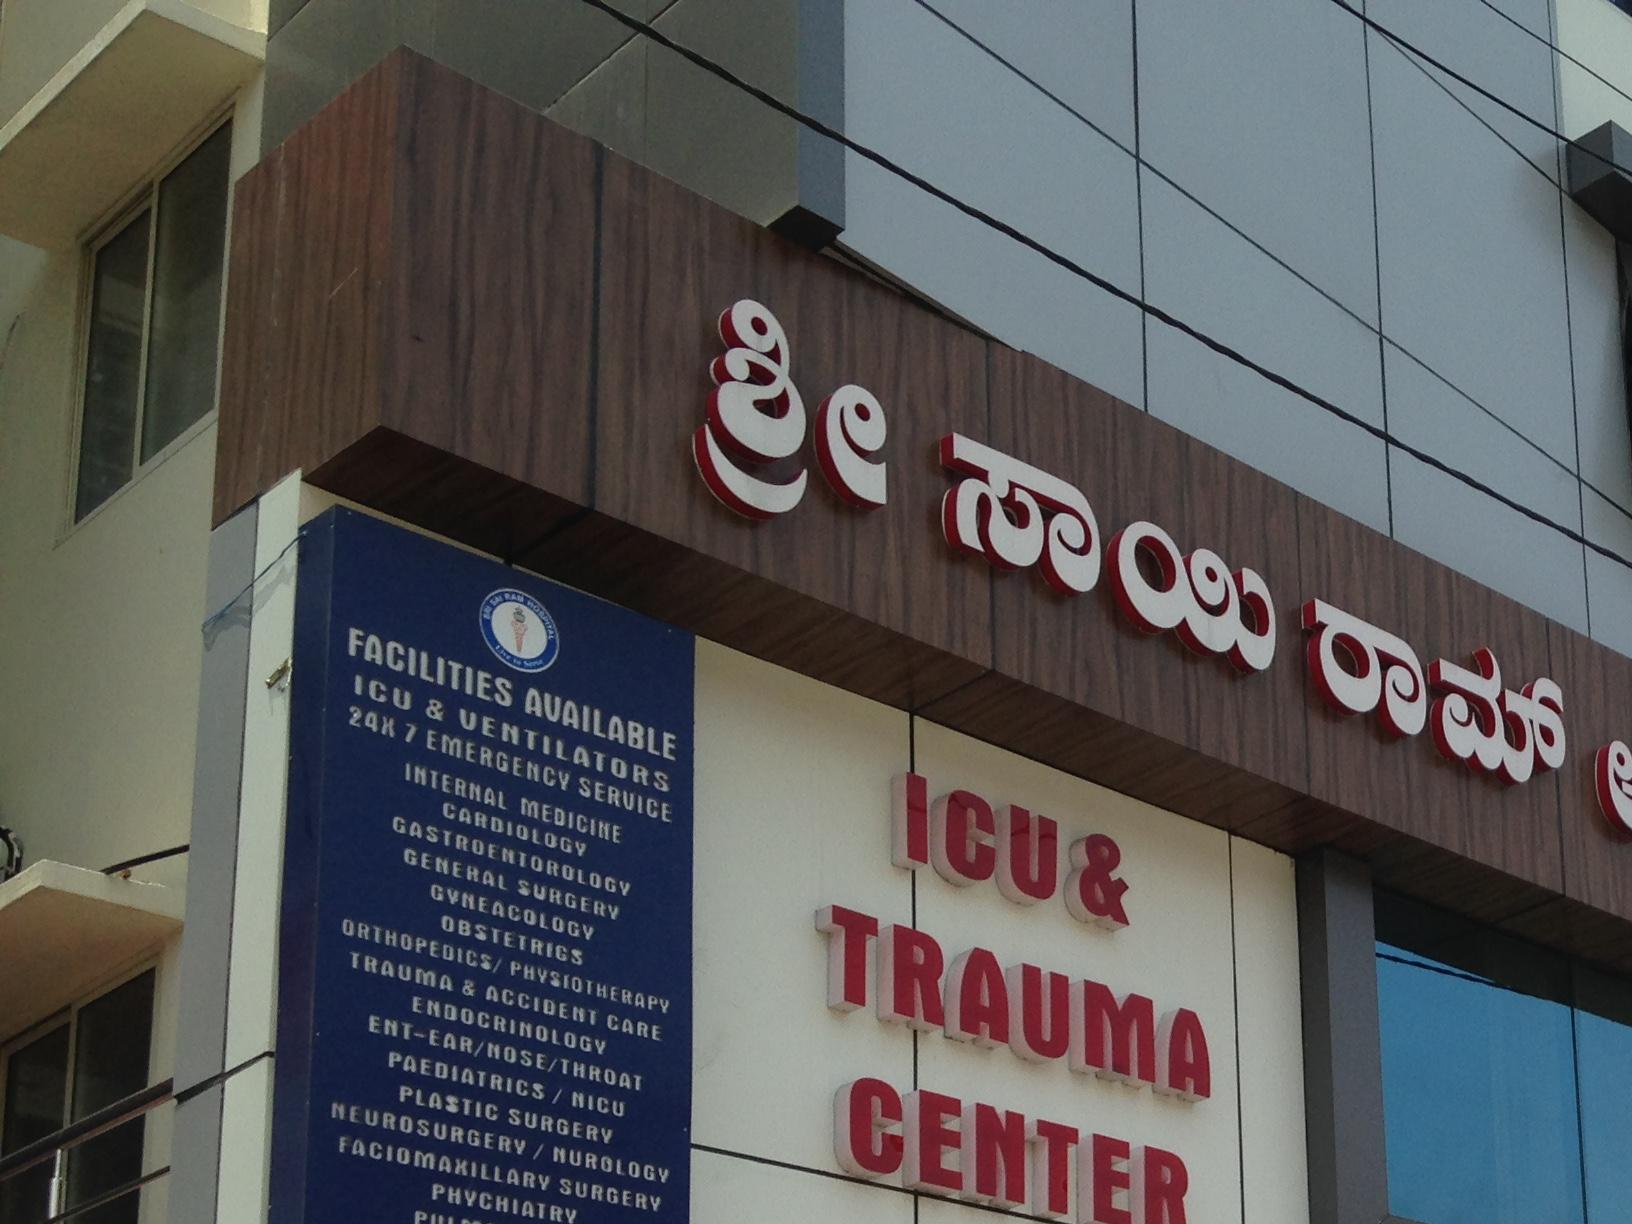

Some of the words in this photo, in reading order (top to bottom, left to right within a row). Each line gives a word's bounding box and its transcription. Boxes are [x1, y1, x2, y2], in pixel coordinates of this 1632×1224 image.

[692, 298, 887, 520] ಶ್ರೀ
[939, 431, 1276, 674] ಸಾಯಿ
[1302, 597, 1566, 784] ರಾಮ್
[348, 627, 513, 707] FACILITIES
[525, 687, 677, 761] AVAILABLE
[354, 675, 410, 711] ICU
[426, 700, 444, 722] &
[459, 708, 670, 792] VENTILATORS
[404, 763, 507, 810] INTERNAL
[521, 798, 622, 844] MEDICINE
[427, 731, 570, 792] EMERGENCY
[578, 777, 673, 823] SERVICE
[392, 817, 631, 897] GASTROENTOROLOGY
[442, 802, 587, 857] CARDIOLOGY
[891, 771, 1058, 906] ICU
[1064, 833, 1130, 931] &
[403, 848, 507, 891] GENERAL
[518, 879, 620, 920] SURGERY
[430, 884, 595, 940] GYNEACOLOGY
[441, 915, 584, 966] OBSTETRICS
[349, 952, 454, 991] TRAUMA
[462, 979, 476, 996] &
[485, 985, 598, 1026] ACCIDENT
[607, 1015, 662, 1041] CARE
[510, 961, 670, 1014] PHYSIOTHERAPY
[815, 904, 1211, 1102] TRAUMA
[368, 1016, 644, 1091] ENT-EAR/NOSE/THROAT
[412, 997, 607, 1055] ENDOCRINOLOGY
[388, 1051, 545, 1100] PAEDIATRICS
[571, 1091, 626, 1118] NICU
[399, 1086, 498, 1121] PLASTIC
[508, 1109, 614, 1144] SURGERY
[331, 1102, 527, 1156] NEUROSURGERY
[552, 1148, 670, 1184] NUROLOGY
[338, 1136, 550, 1192] FACIOMAXILLARY
[559, 1179, 661, 1212] SURGERY
[432, 1183, 577, 1224] PHYCHIATRY
